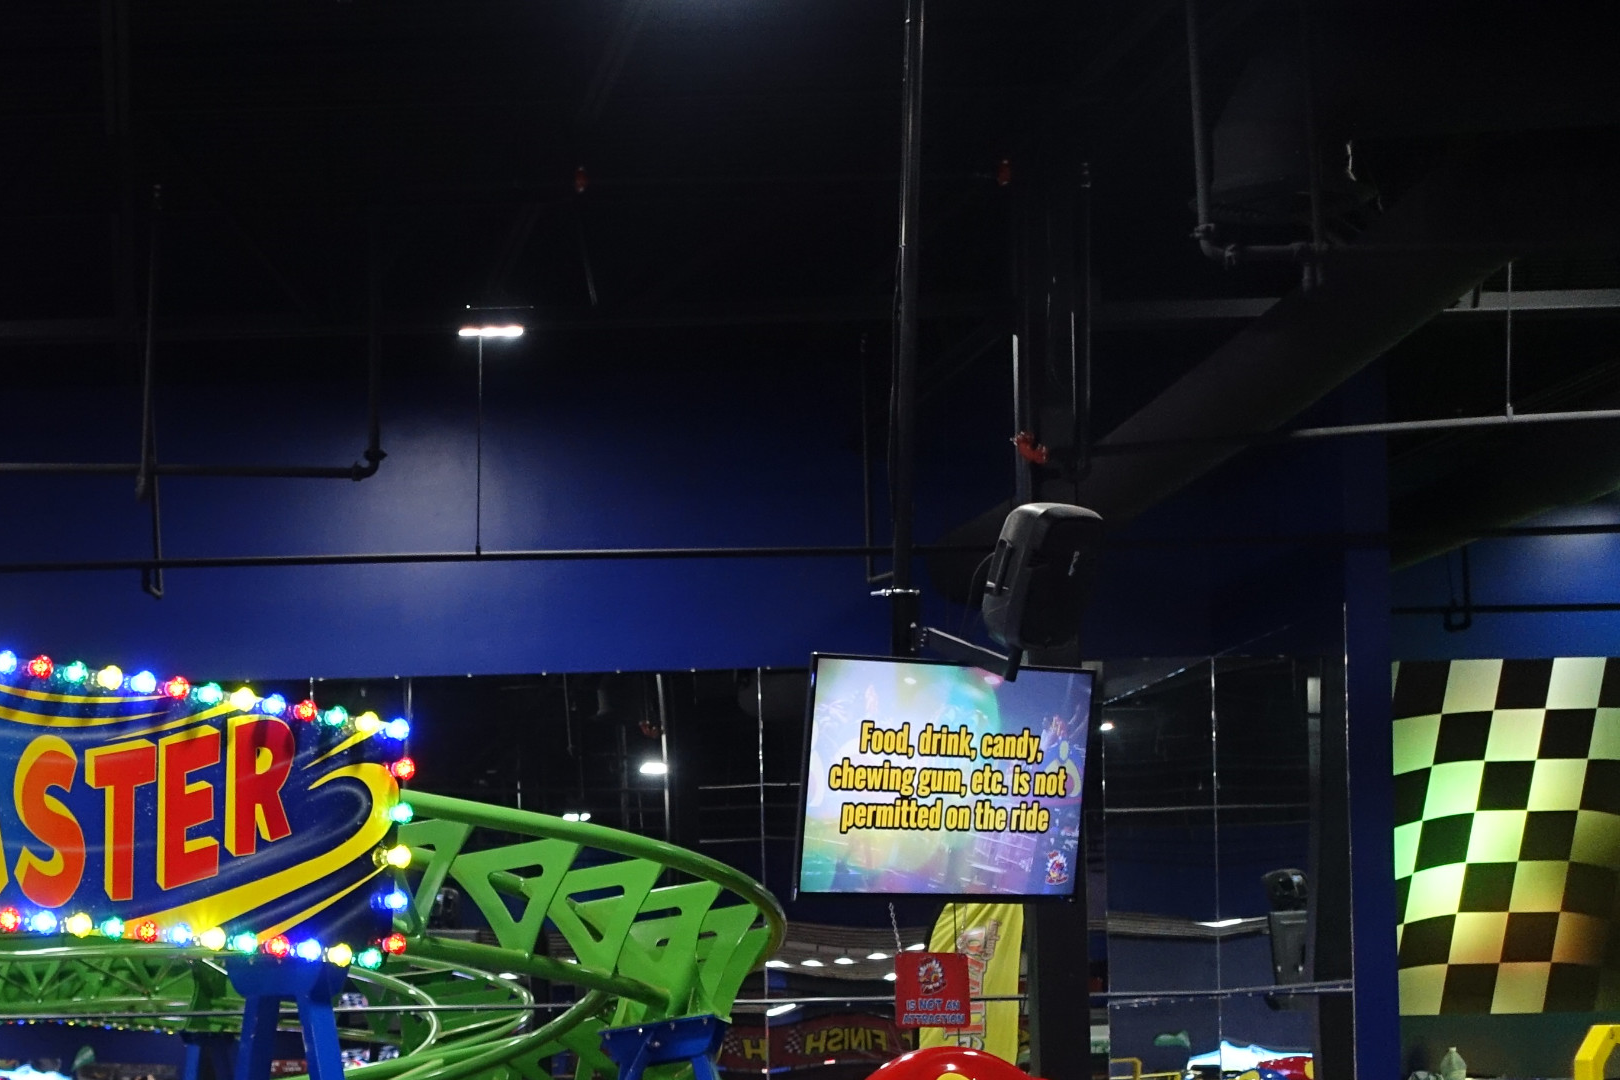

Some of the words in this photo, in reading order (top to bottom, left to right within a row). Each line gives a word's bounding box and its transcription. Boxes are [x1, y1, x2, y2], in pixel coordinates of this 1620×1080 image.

[860, 721, 914, 757] Food,
[918, 724, 977, 760] drink,
[980, 728, 1043, 763] candy,
[829, 758, 916, 796] chewing
[917, 767, 966, 797] gum,
[971, 765, 1008, 795] etc.
[1012, 766, 1030, 796] is
[1034, 767, 1067, 797] not
[840, 798, 942, 833] permitted
[945, 806, 971, 830] on
[975, 801, 1006, 831] the
[1010, 803, 1050, 832] ride
[902, 1013, 965, 1025] ATTRACTION
[906, 1000, 916, 1010] IS
[918, 998, 943, 1010] NOT
[945, 999, 960, 1010] AN
